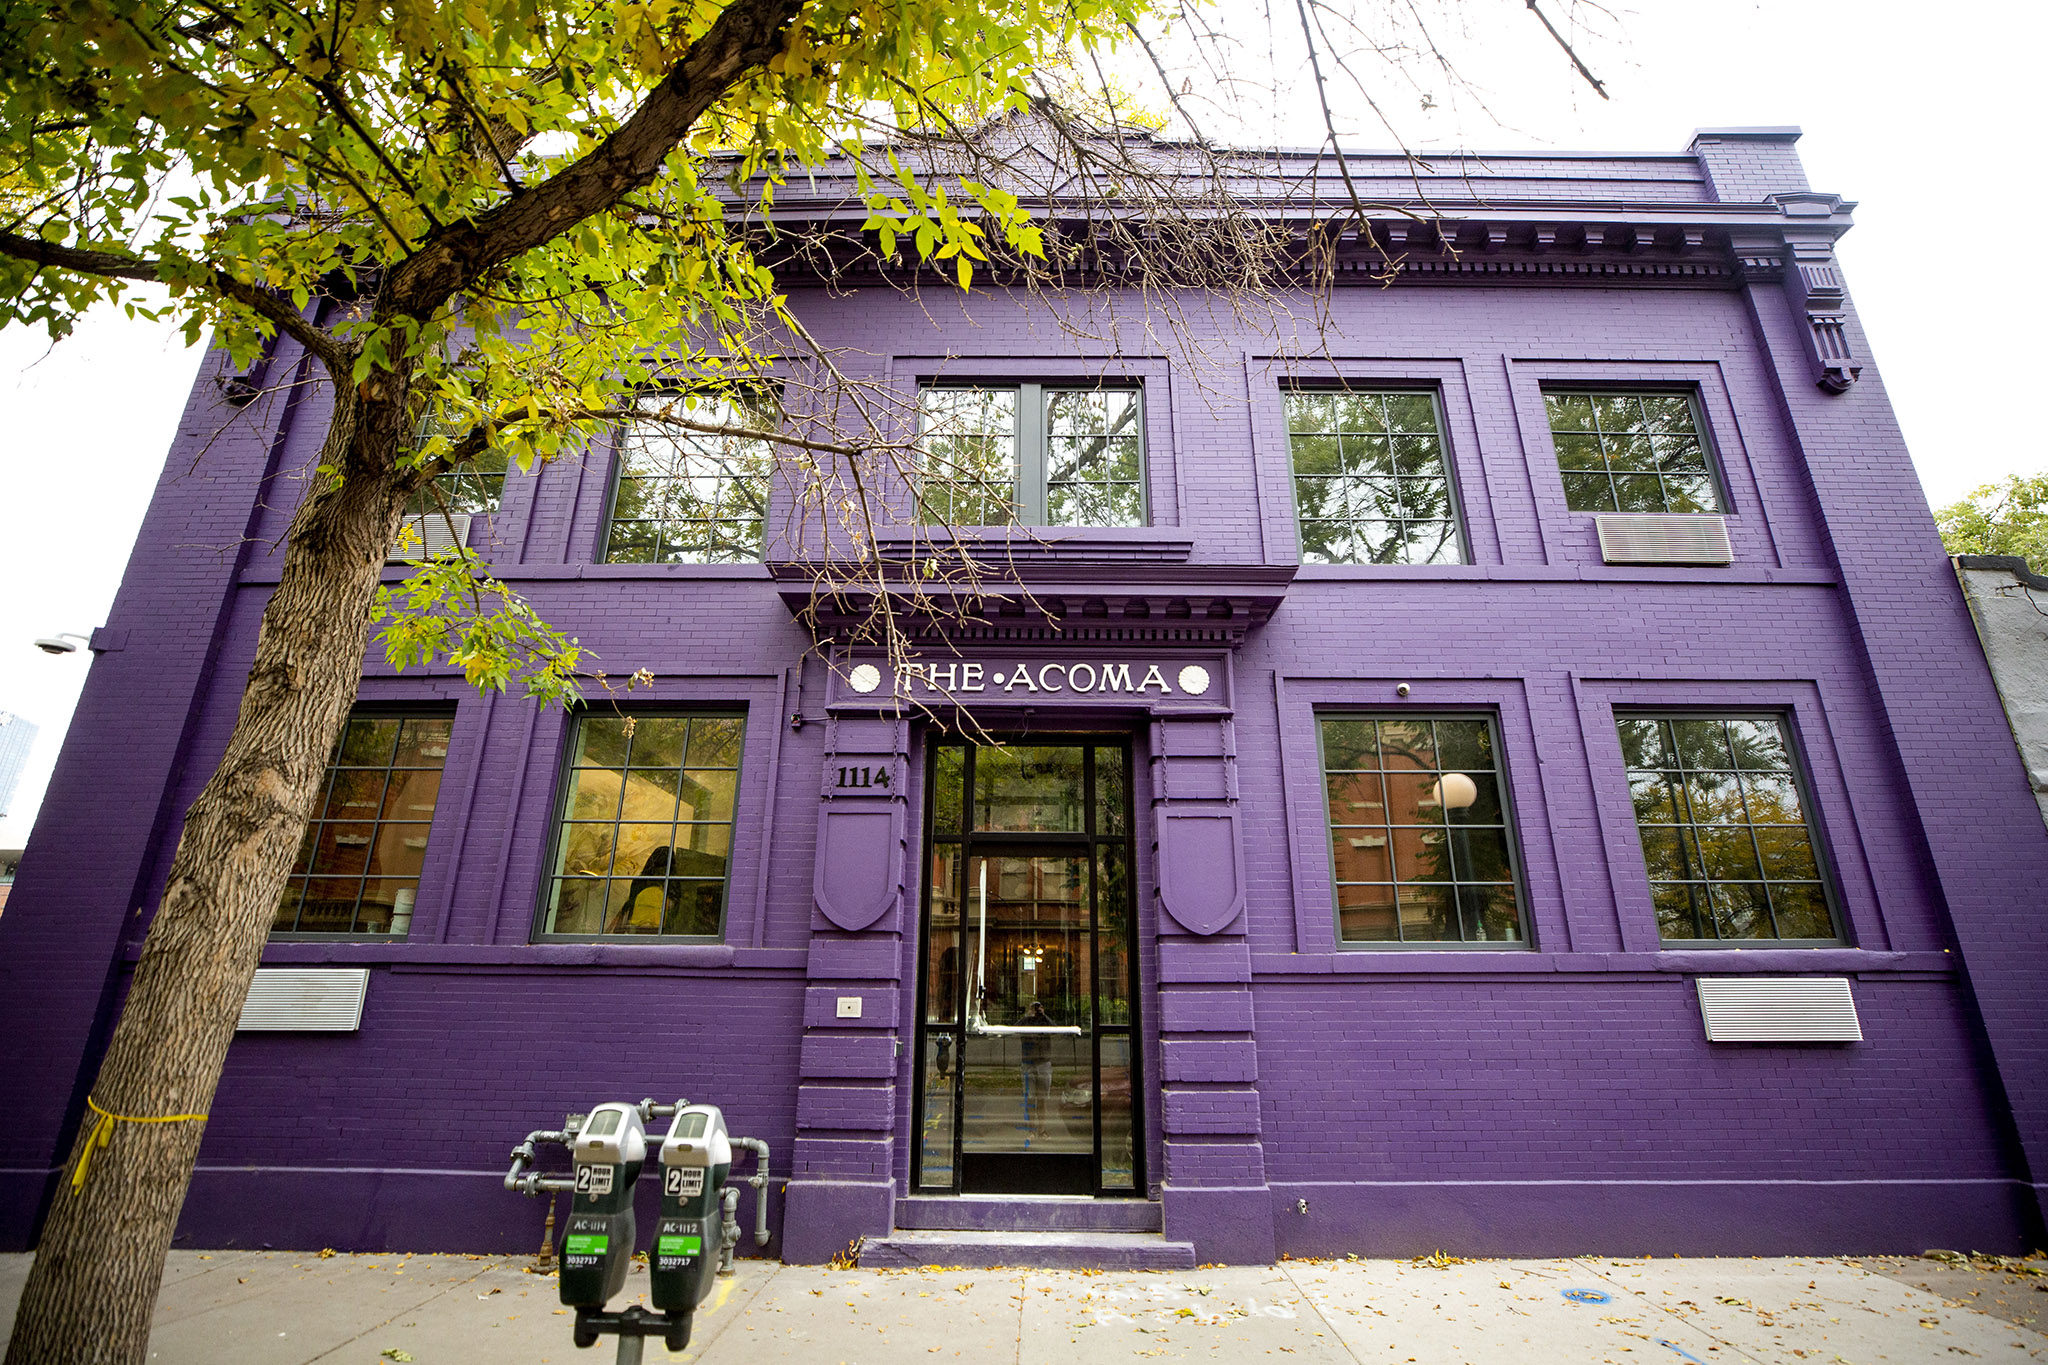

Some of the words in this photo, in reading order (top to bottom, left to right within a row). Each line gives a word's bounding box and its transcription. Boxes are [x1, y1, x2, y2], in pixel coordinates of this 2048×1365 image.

[899, 663, 985, 692] THE
[1004, 663, 1172, 693] ACOMA
[835, 766, 891, 788] 1114
[578, 1167, 590, 1189] 2
[593, 1168, 611, 1176] HOUR
[592, 1177, 611, 1186] LIMIT
[668, 1170, 681, 1192] 2
[683, 1170, 702, 1178] HOUR
[682, 1180, 702, 1189] LIMIT
[574, 1220, 607, 1232] AC-1114
[662, 1222, 698, 1234] AC-1112
[566, 1255, 598, 1265] 3032717
[658, 1256, 691, 1266] 3032717
